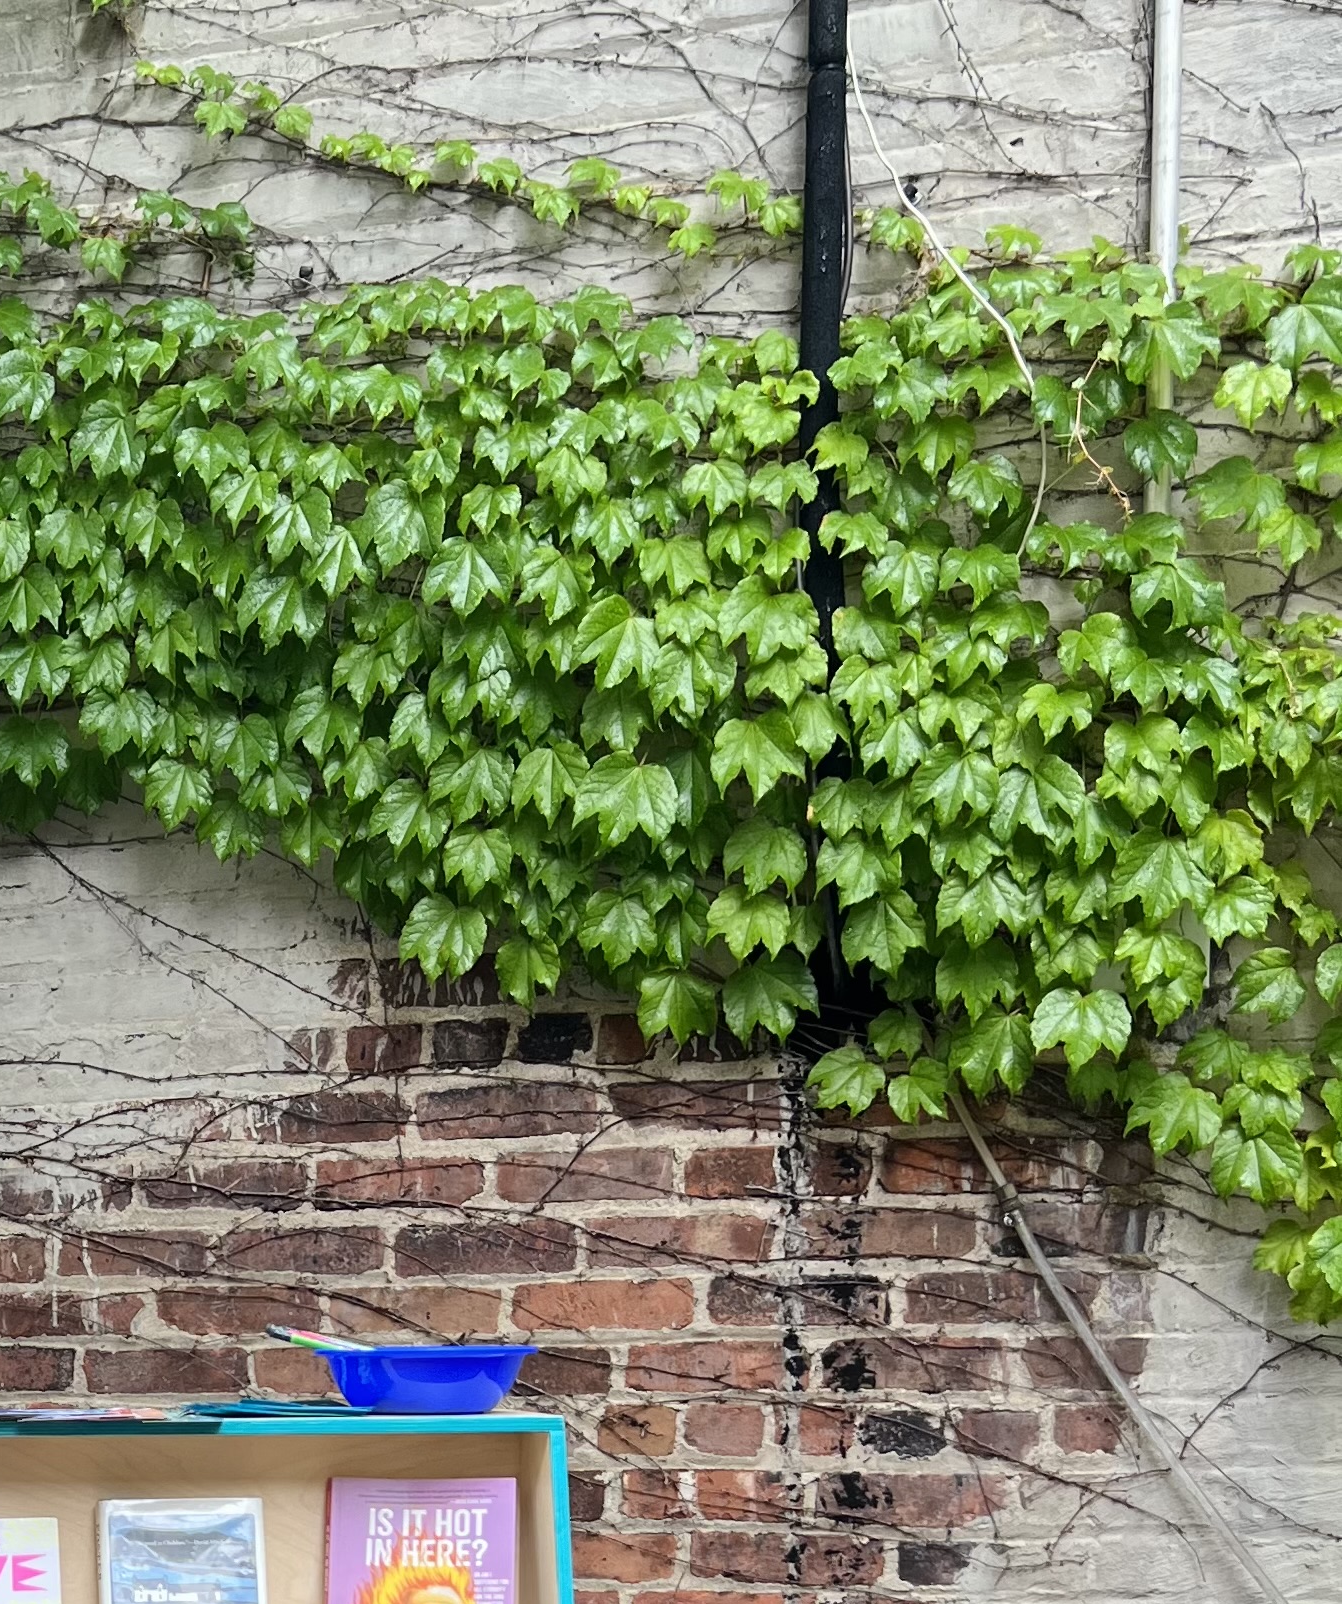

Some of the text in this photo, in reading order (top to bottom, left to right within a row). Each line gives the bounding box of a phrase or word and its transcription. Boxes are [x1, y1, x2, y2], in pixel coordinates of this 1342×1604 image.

[369, 1508, 488, 1537] IS IT HOT
[365, 1538, 488, 1567] IN HERE?
